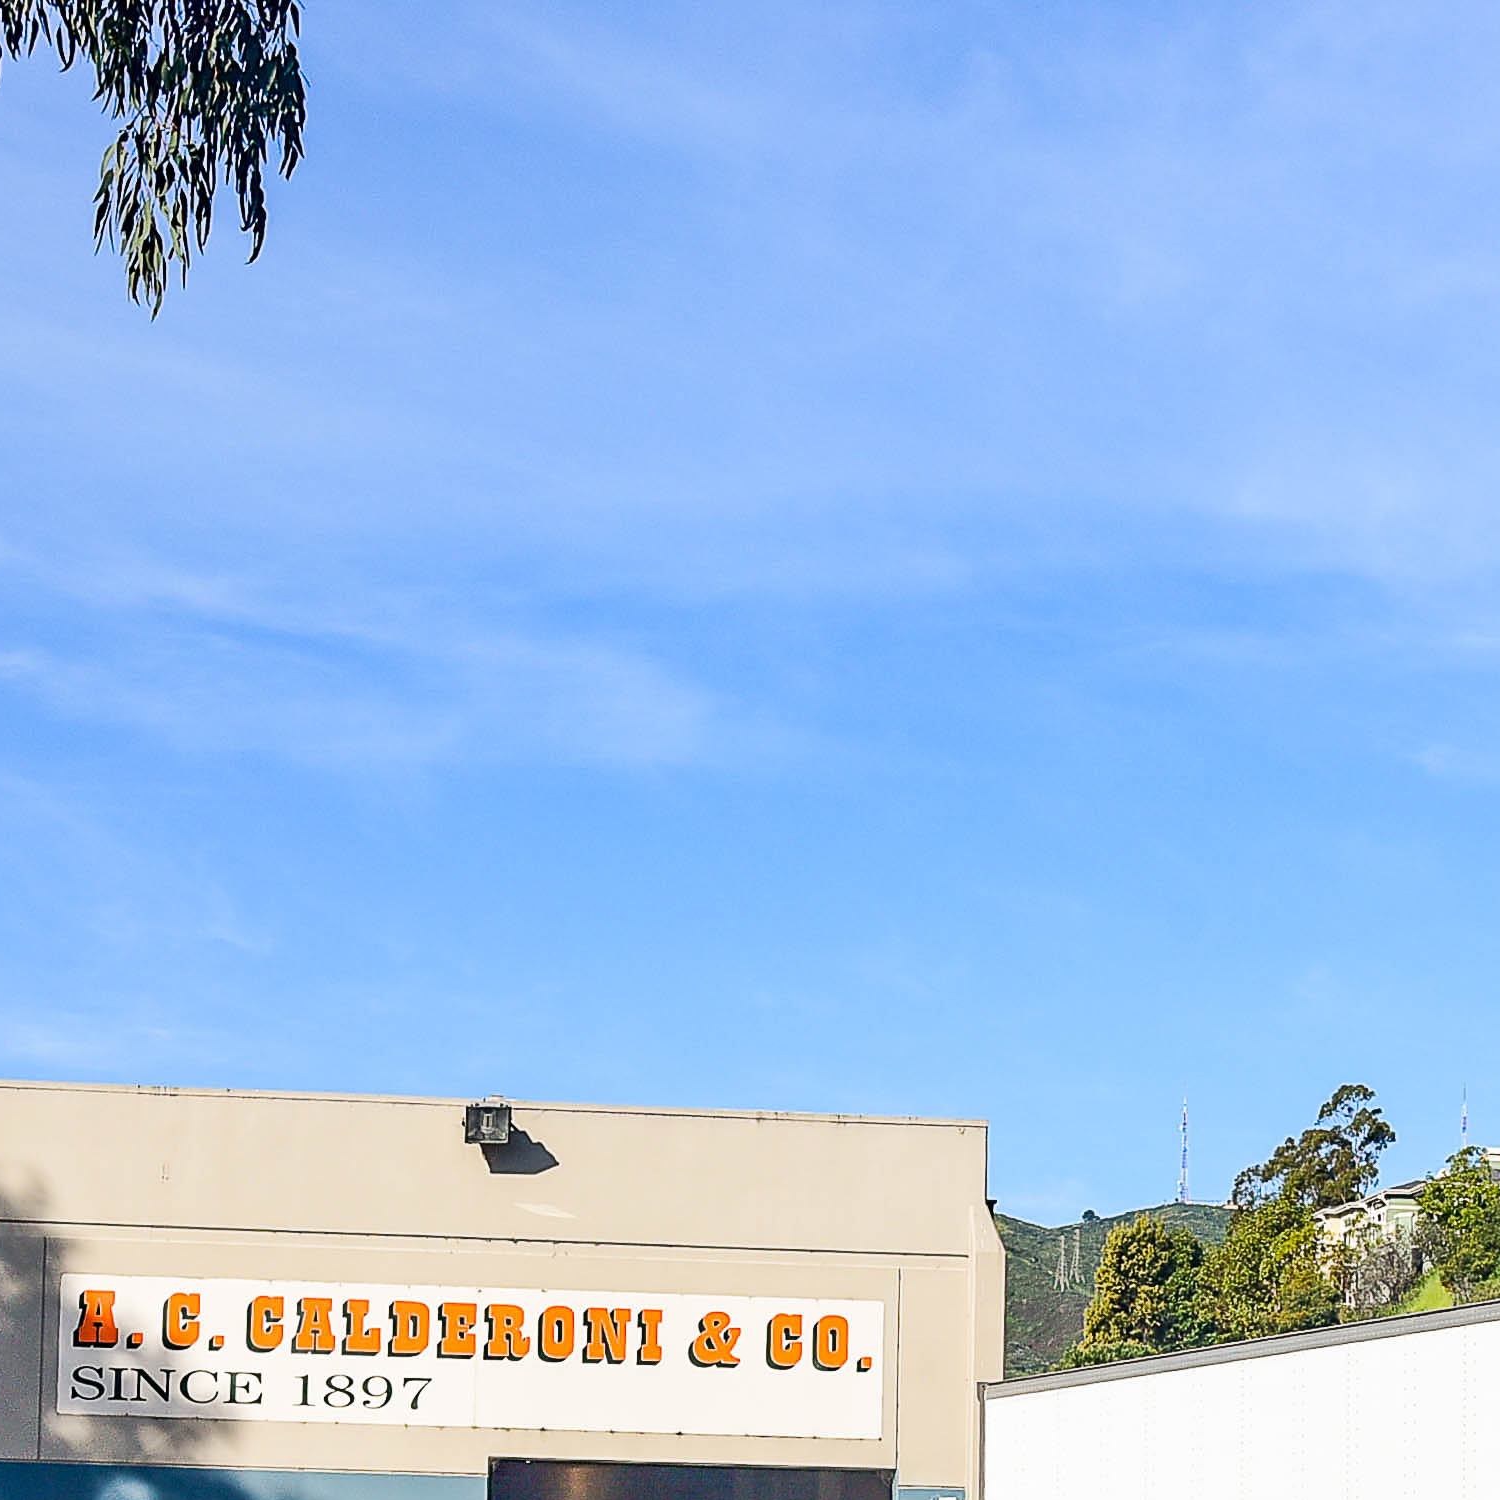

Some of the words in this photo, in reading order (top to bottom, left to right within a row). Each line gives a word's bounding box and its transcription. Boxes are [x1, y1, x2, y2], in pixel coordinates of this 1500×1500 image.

[73, 1288, 143, 1349] A.
[162, 1292, 224, 1351] C.
[246, 1295, 663, 1364] CALDERONI
[689, 1311, 741, 1368] &
[765, 1313, 874, 1372] CO.
[70, 1365, 264, 1405] SINCE
[292, 1375, 434, 1411] 1897
